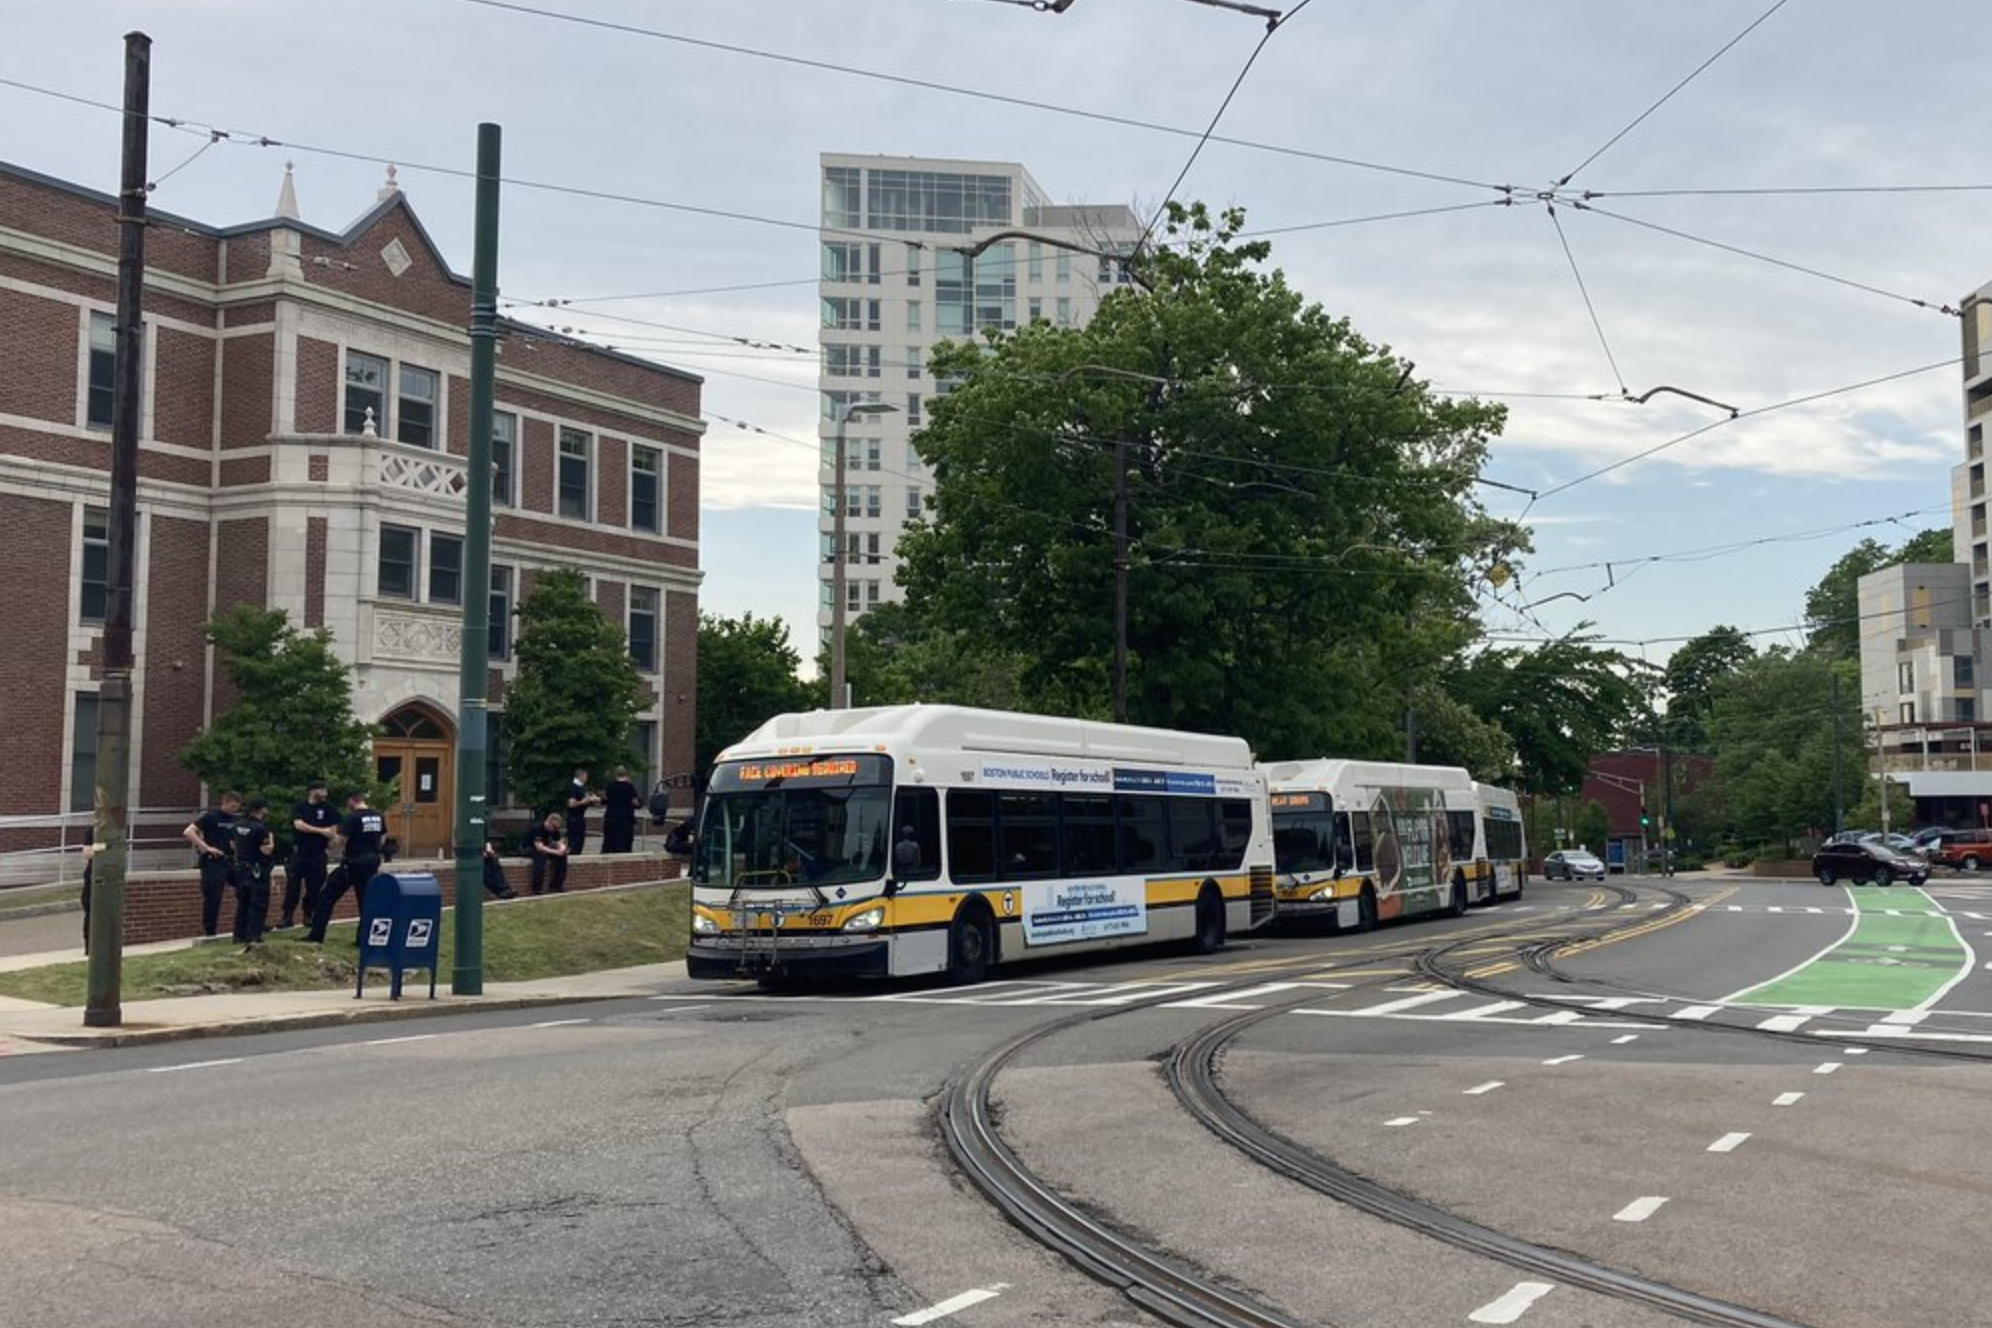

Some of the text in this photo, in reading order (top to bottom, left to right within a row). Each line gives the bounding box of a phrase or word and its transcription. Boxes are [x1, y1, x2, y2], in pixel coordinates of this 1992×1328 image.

[1051, 768, 1078, 786] Register
[1080, 768, 1089, 783] for
[1057, 894, 1082, 909] Register
[808, 914, 833, 926] 1697
